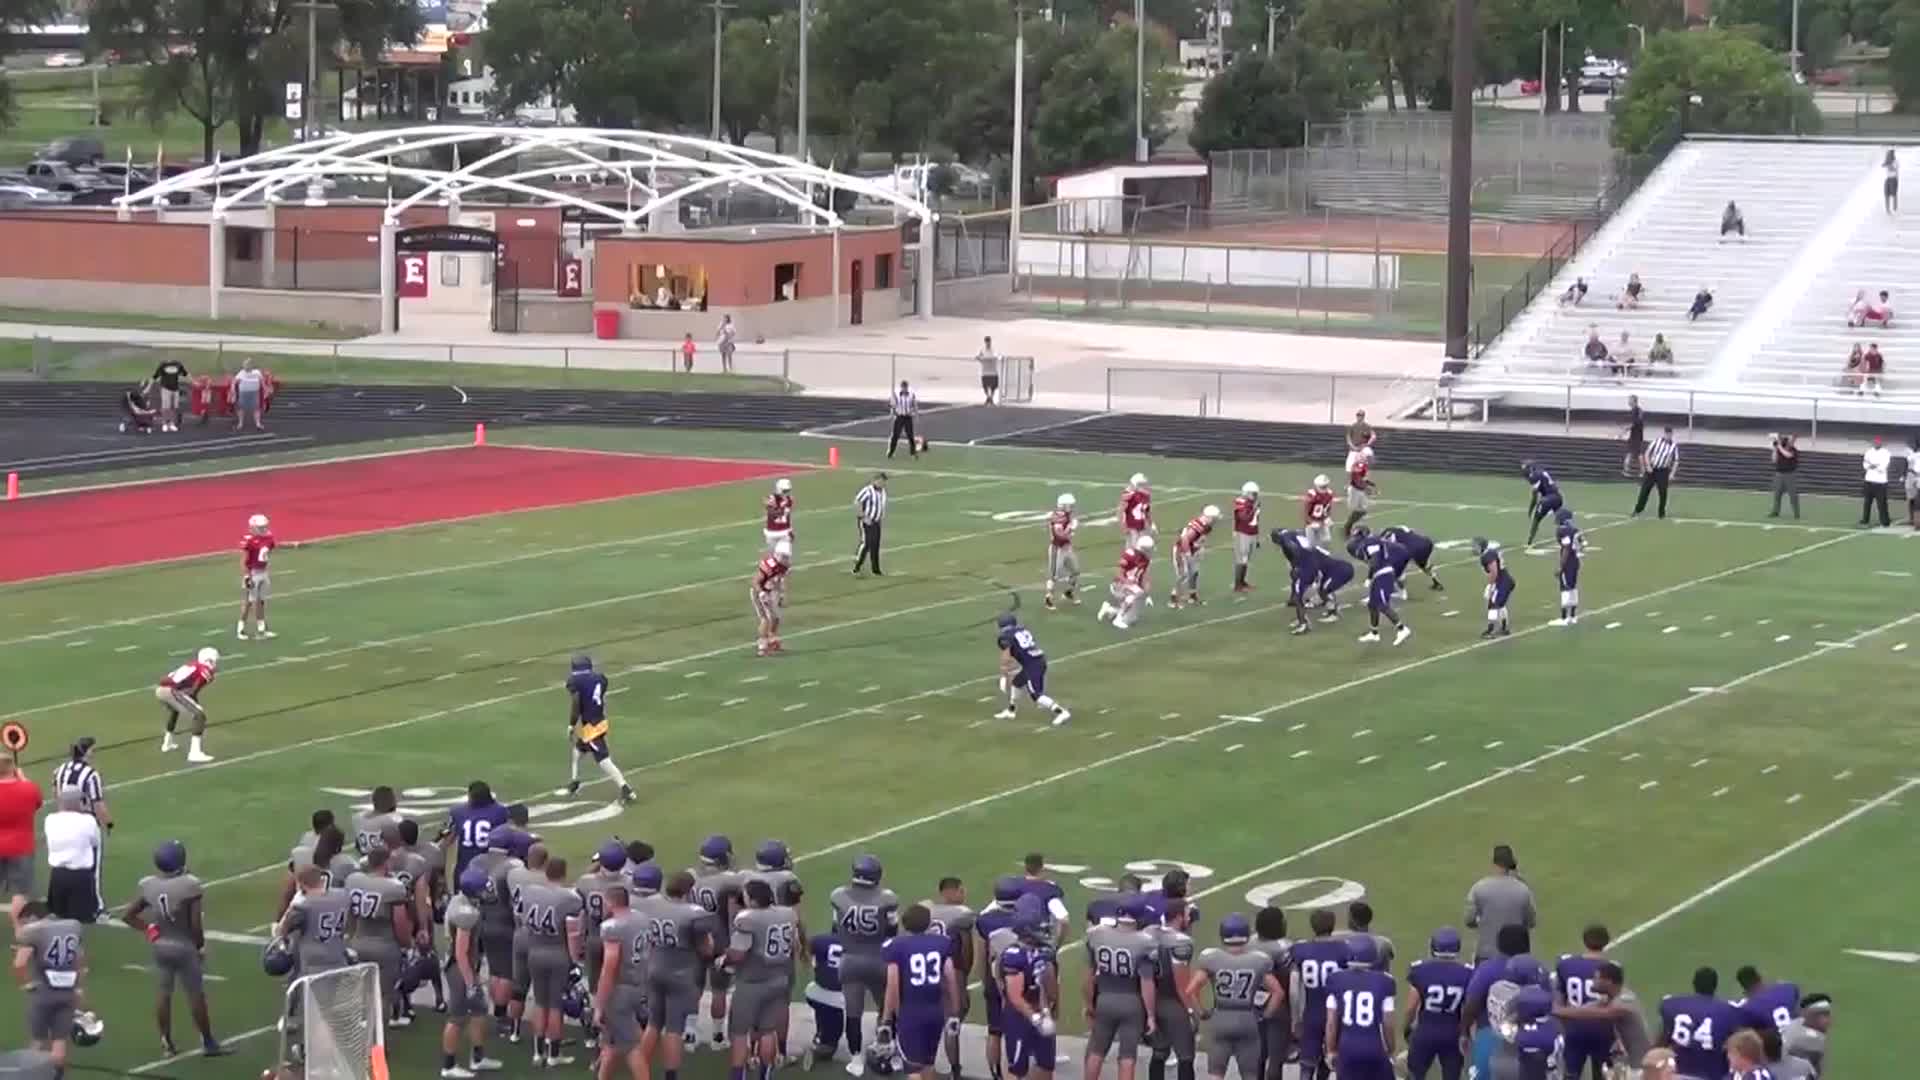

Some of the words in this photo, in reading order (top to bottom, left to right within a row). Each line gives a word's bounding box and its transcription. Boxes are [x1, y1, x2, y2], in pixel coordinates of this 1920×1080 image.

[404, 257, 425, 285] E
[462, 819, 491, 848] 16
[526, 903, 559, 936] 44
[840, 904, 880, 935] 45
[763, 921, 794, 959] 65
[909, 950, 941, 987] 93
[1214, 967, 1255, 1001] 27
[1342, 989, 1375, 1028] 18
[1424, 984, 1464, 1013] 27
[1671, 1013, 1714, 1050] 64
